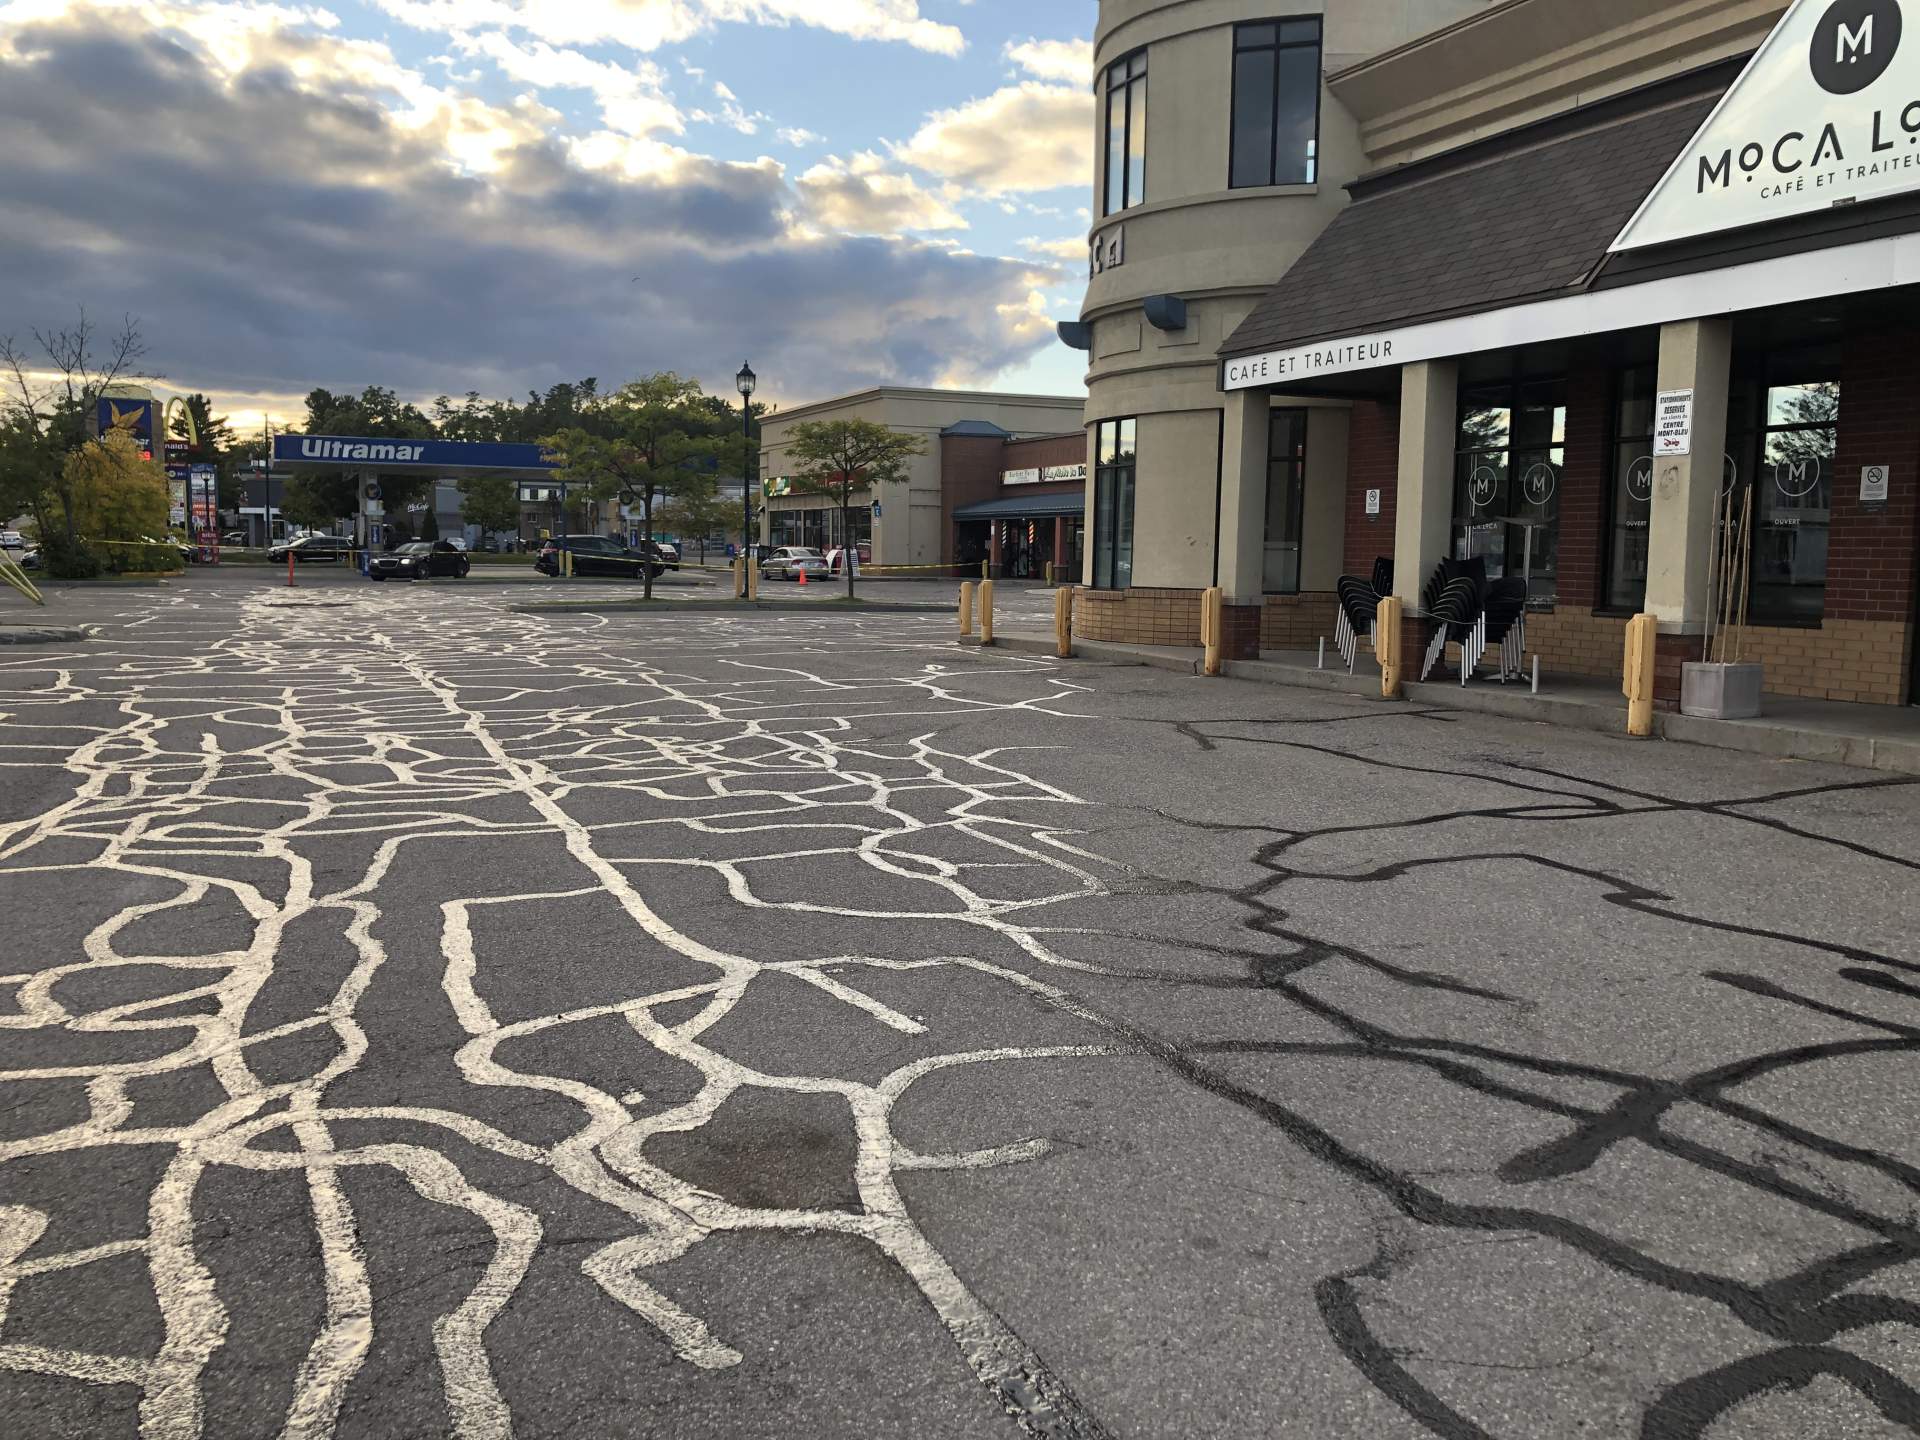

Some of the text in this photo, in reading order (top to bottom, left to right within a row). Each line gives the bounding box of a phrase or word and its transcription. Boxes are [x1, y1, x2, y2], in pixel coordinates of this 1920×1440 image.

[1835, 14, 1874, 64] M
[1760, 176, 1804, 199] CAFÉ
[1816, 172, 1835, 187] ET
[1230, 340, 1392, 381] CAFÉ ET TRAITEUR
[1657, 428, 1689, 437] MONT-BLEU
[1662, 421, 1684, 429] CENTRE
[301, 438, 425, 461] Ultramar
[1774, 518, 1800, 526] OUVERT
